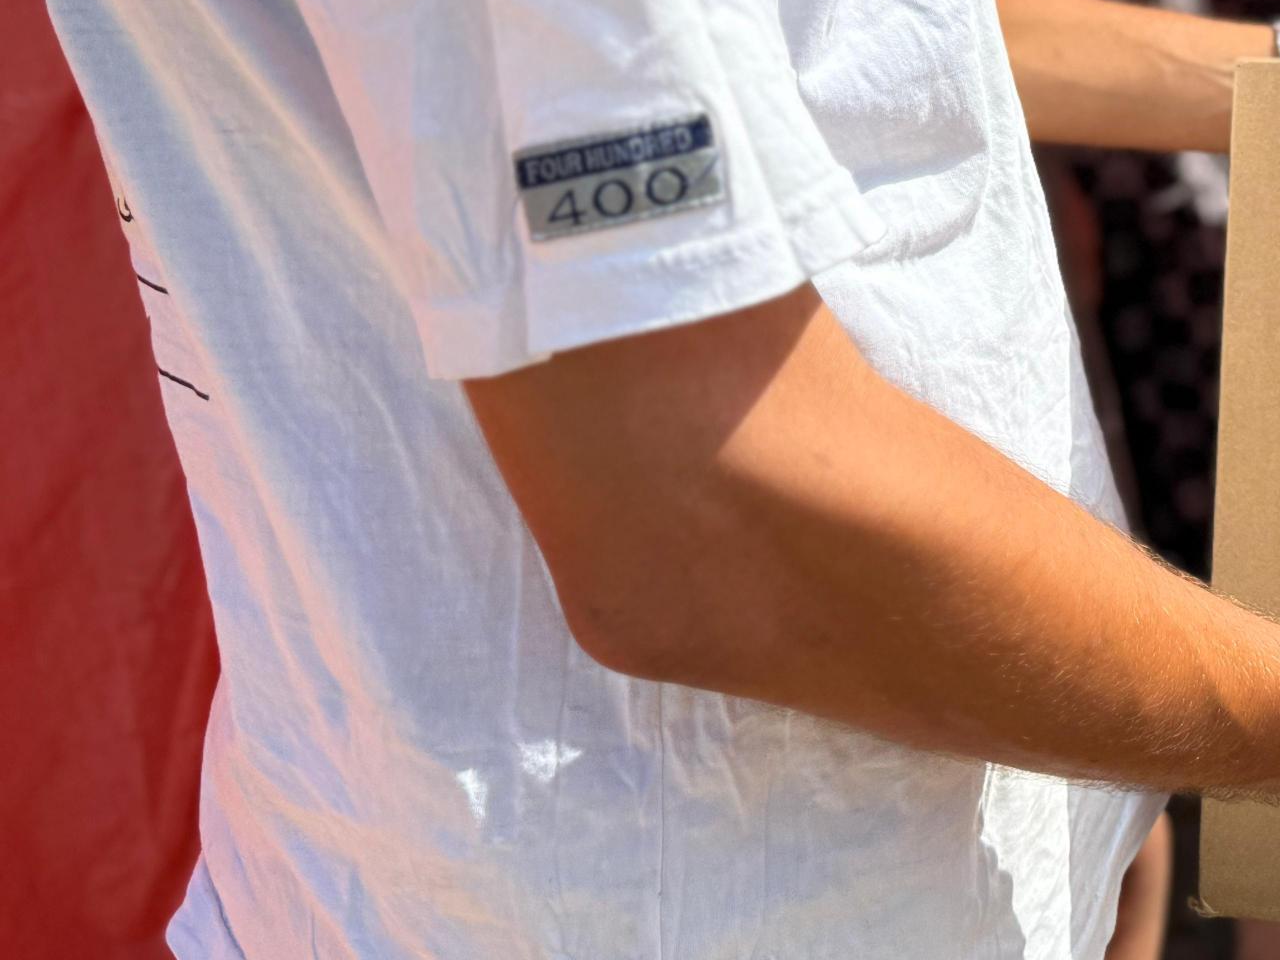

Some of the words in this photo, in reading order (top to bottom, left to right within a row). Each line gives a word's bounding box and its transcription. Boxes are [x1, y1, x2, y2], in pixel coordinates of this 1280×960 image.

[524, 153, 583, 185] FOUR
[585, 127, 692, 170] HUNDRED
[547, 167, 688, 227] 400
